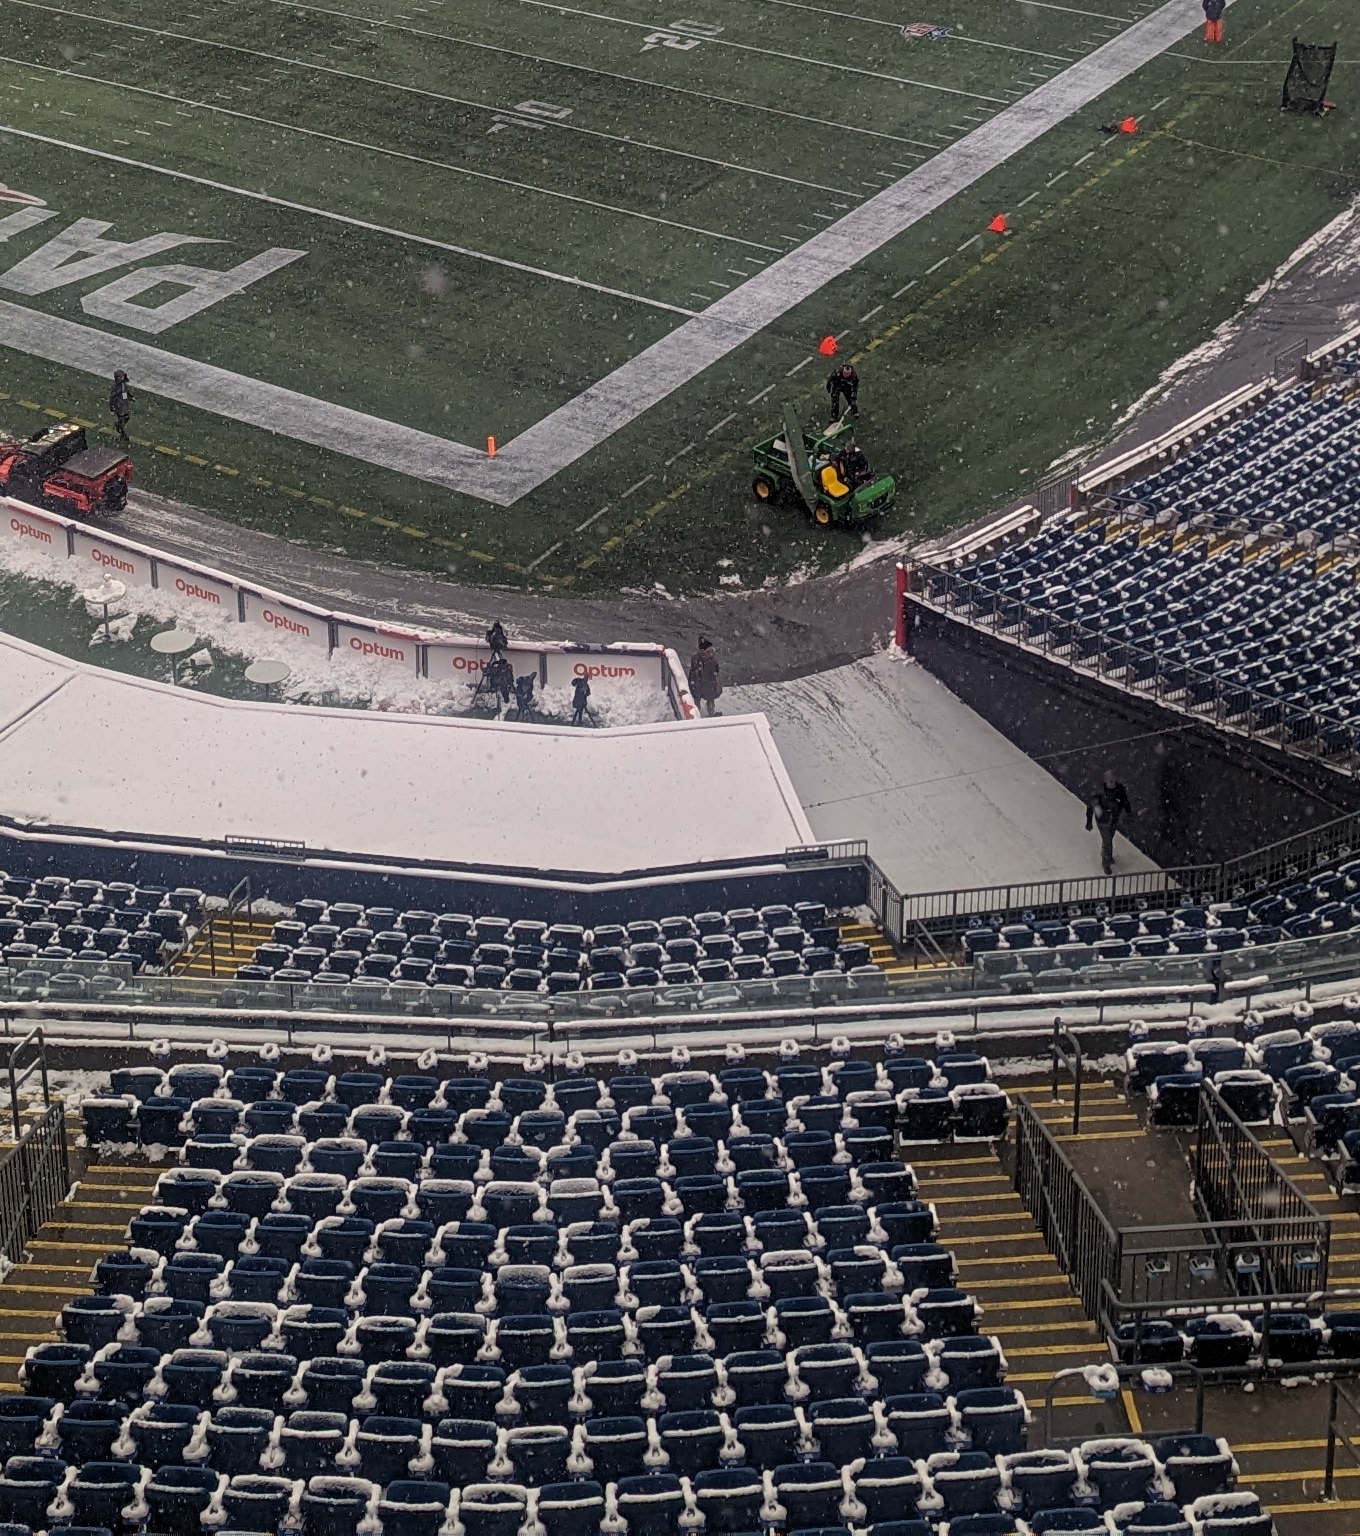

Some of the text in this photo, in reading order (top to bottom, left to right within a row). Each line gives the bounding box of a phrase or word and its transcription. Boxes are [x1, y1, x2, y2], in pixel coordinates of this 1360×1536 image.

[642, 17, 724, 52] 20
[492, 99, 573, 131] 10
[10, 517, 52, 544] Optum
[90, 547, 135, 575] Optum
[174, 577, 221, 606] Optum
[261, 608, 311, 637] Optum
[348, 636, 405, 662] Optum
[572, 662, 636, 680] Optum
